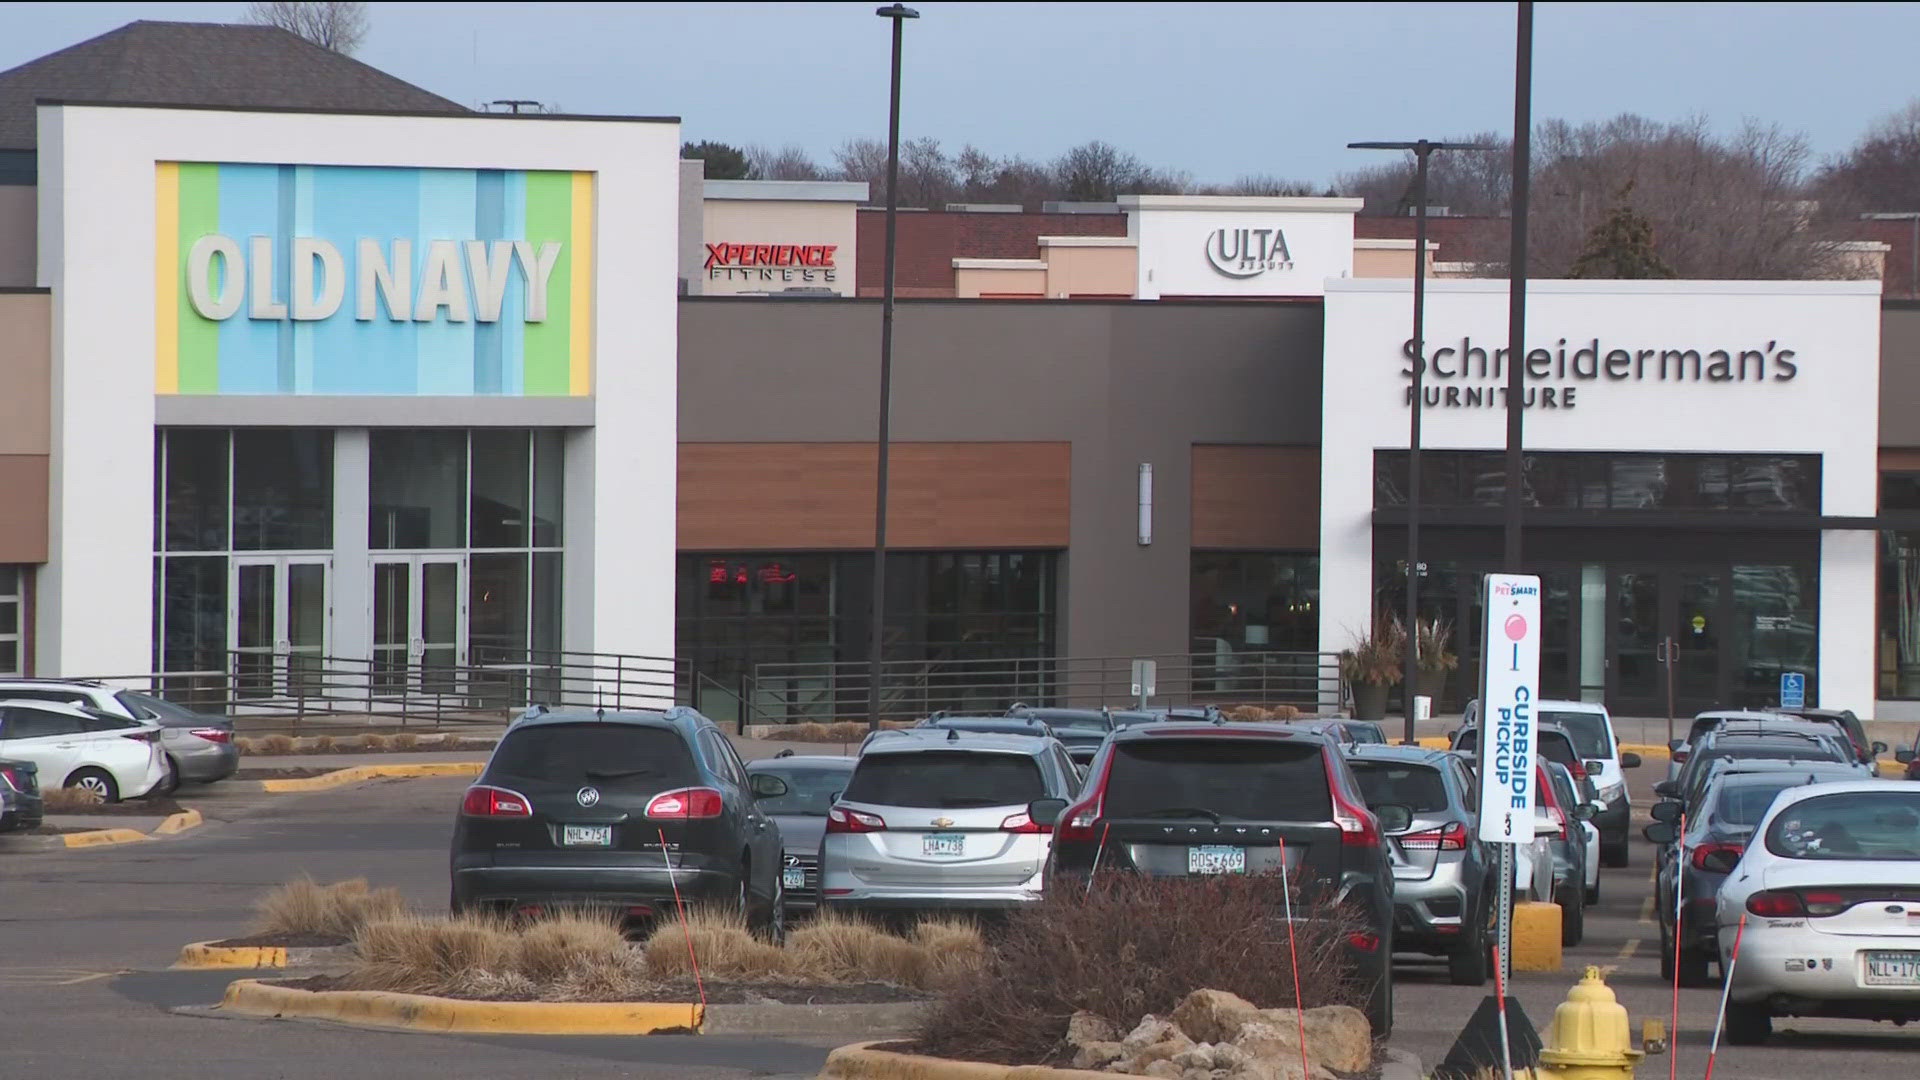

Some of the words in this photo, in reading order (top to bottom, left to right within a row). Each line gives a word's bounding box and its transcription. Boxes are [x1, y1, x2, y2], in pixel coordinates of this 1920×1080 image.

[704, 243, 838, 269] XPERIENCE
[1218, 229, 1291, 262] ULTA
[186, 233, 346, 322] OLD
[354, 237, 563, 323] NAVY
[710, 269, 836, 281] FITNESS
[1401, 336, 1798, 383] Schneiderman's
[1495, 585, 1537, 596] PETSMART
[1495, 707, 1511, 785] PICKUP
[1511, 685, 1530, 809] CURBSIDE
[1504, 817, 1511, 836] 3
